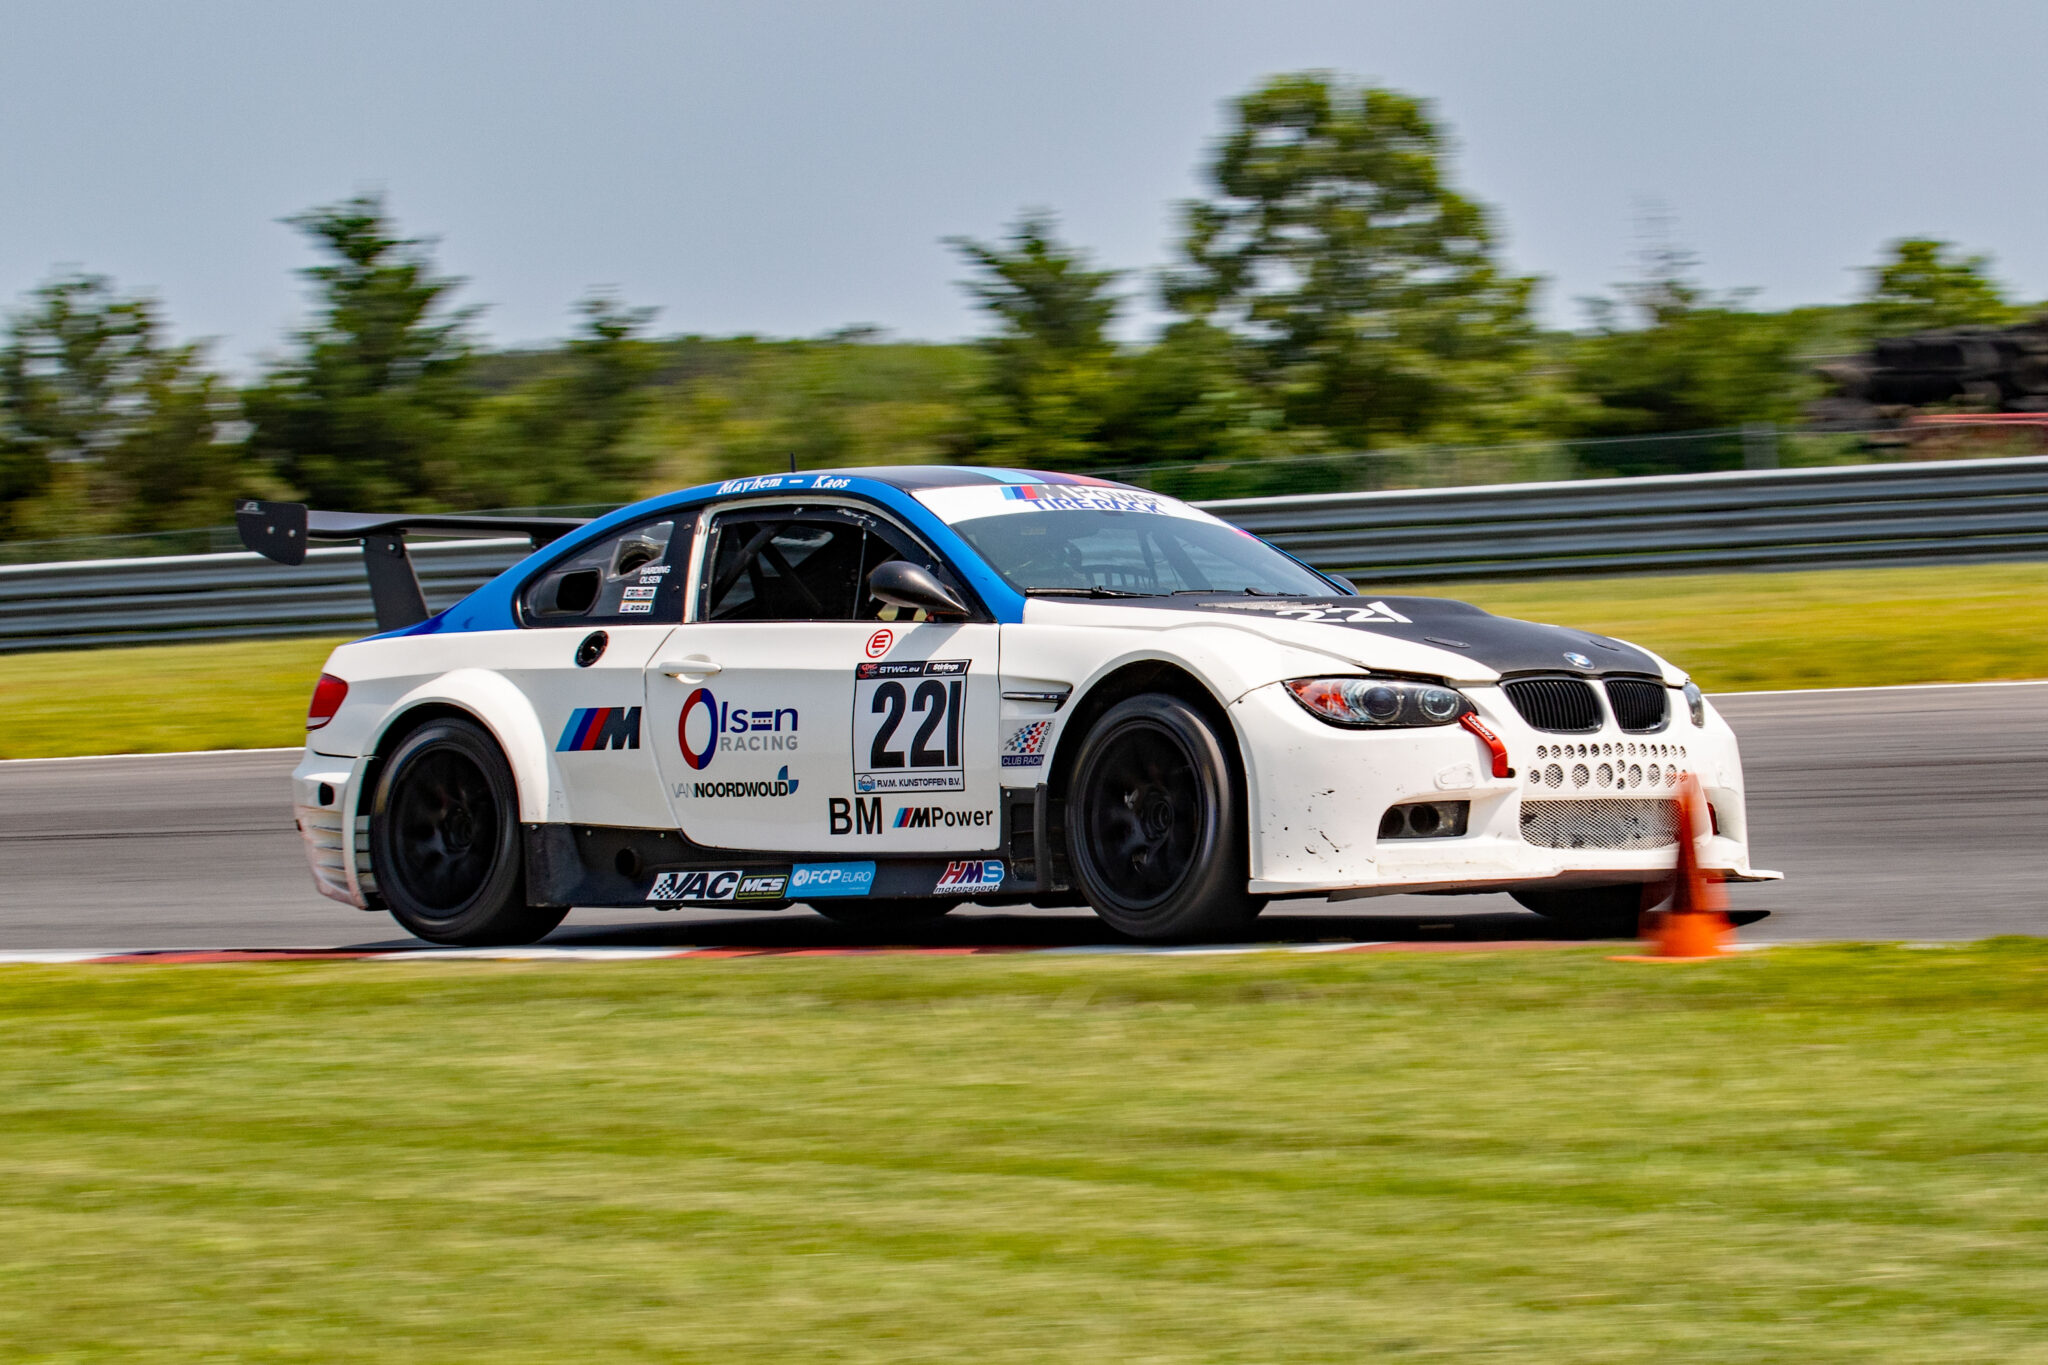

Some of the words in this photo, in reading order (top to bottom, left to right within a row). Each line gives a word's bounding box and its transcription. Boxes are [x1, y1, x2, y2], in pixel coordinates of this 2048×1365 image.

[716, 477, 783, 495] Mayhem
[811, 475, 851, 488] Kaos
[640, 565, 671, 575] HARDING
[639, 576, 662, 584] OLSEN
[1276, 601, 1413, 623] 221
[872, 635, 889, 648] E
[879, 665, 920, 674] STWC.eu
[678, 688, 798, 770] Olsen
[870, 679, 962, 769] 221
[720, 735, 798, 752] RACING
[1002, 756, 1022, 766] CLUB
[899, 778, 947, 787] KUNSTOFFEN
[949, 777, 961, 786] B.V.
[829, 797, 883, 835] BM
[808, 869, 842, 885] FCP
[841, 871, 871, 883] EURO
[938, 861, 1004, 885] HMS
[666, 872, 739, 899] VAC
[740, 877, 785, 893] MCS
[934, 884, 1000, 895] motorsport
